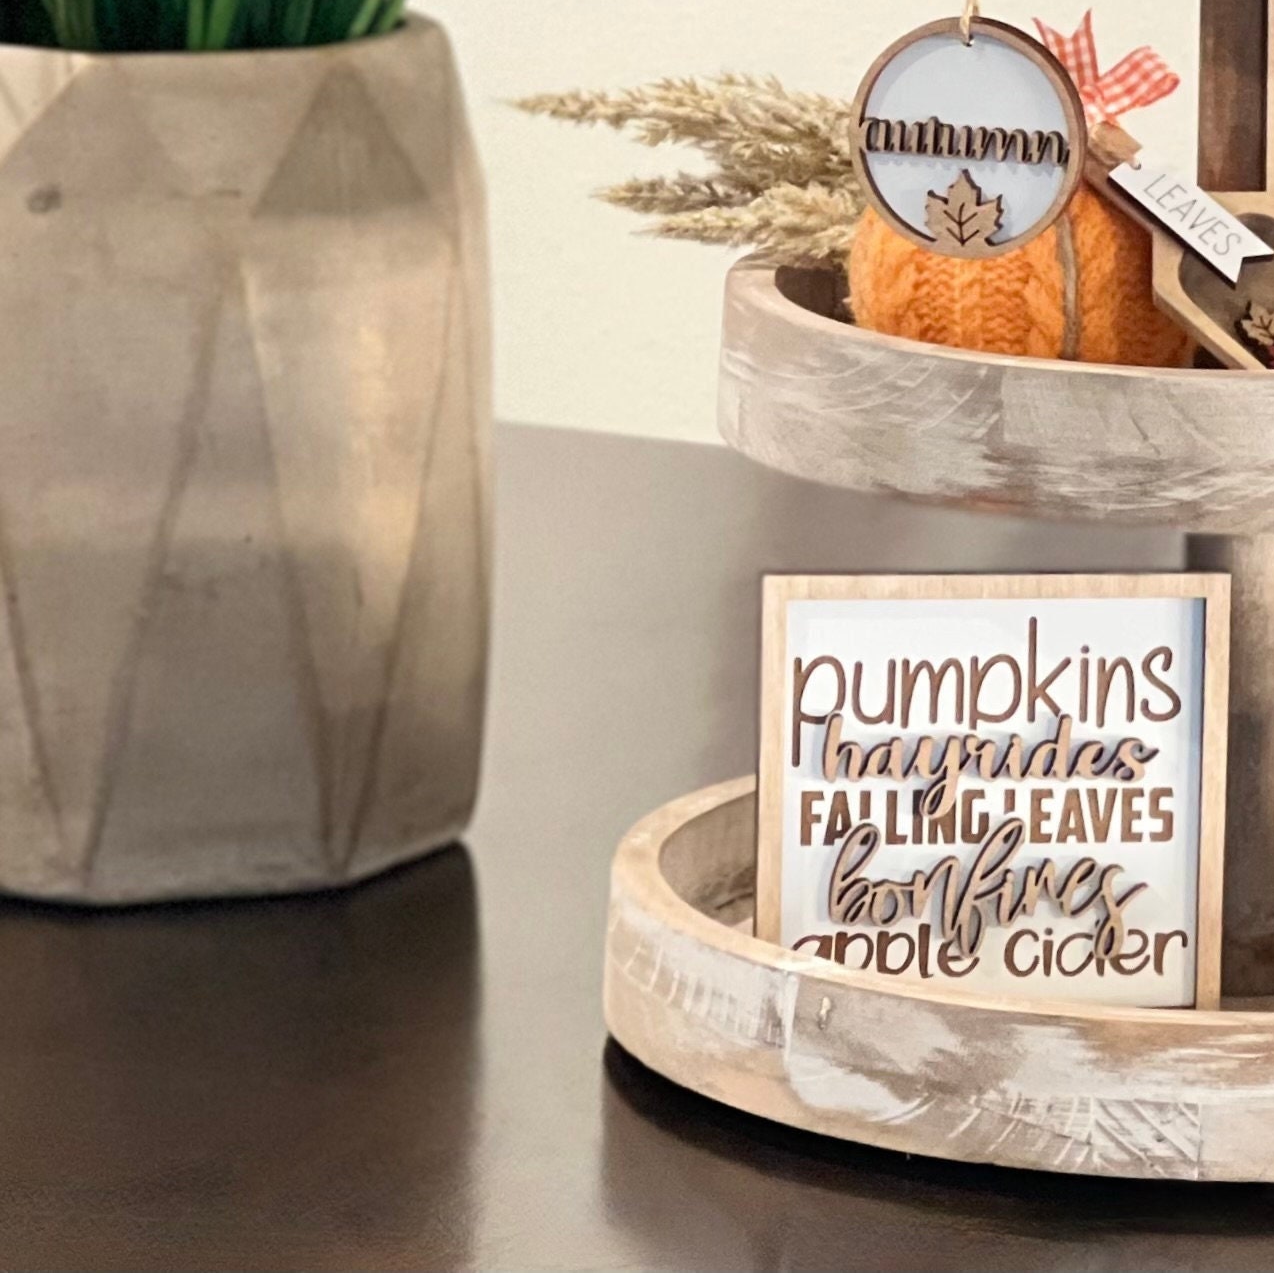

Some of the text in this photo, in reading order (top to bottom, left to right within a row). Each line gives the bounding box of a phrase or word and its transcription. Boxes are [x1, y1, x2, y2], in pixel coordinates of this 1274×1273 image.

[864, 116, 1070, 165] autumn
[1143, 173, 1242, 257] LEAVES
[790, 615, 1183, 768] pumpkins
[821, 712, 1160, 820] hayrides
[828, 817, 1150, 960] bonfires
[1003, 927, 1189, 978] cider
